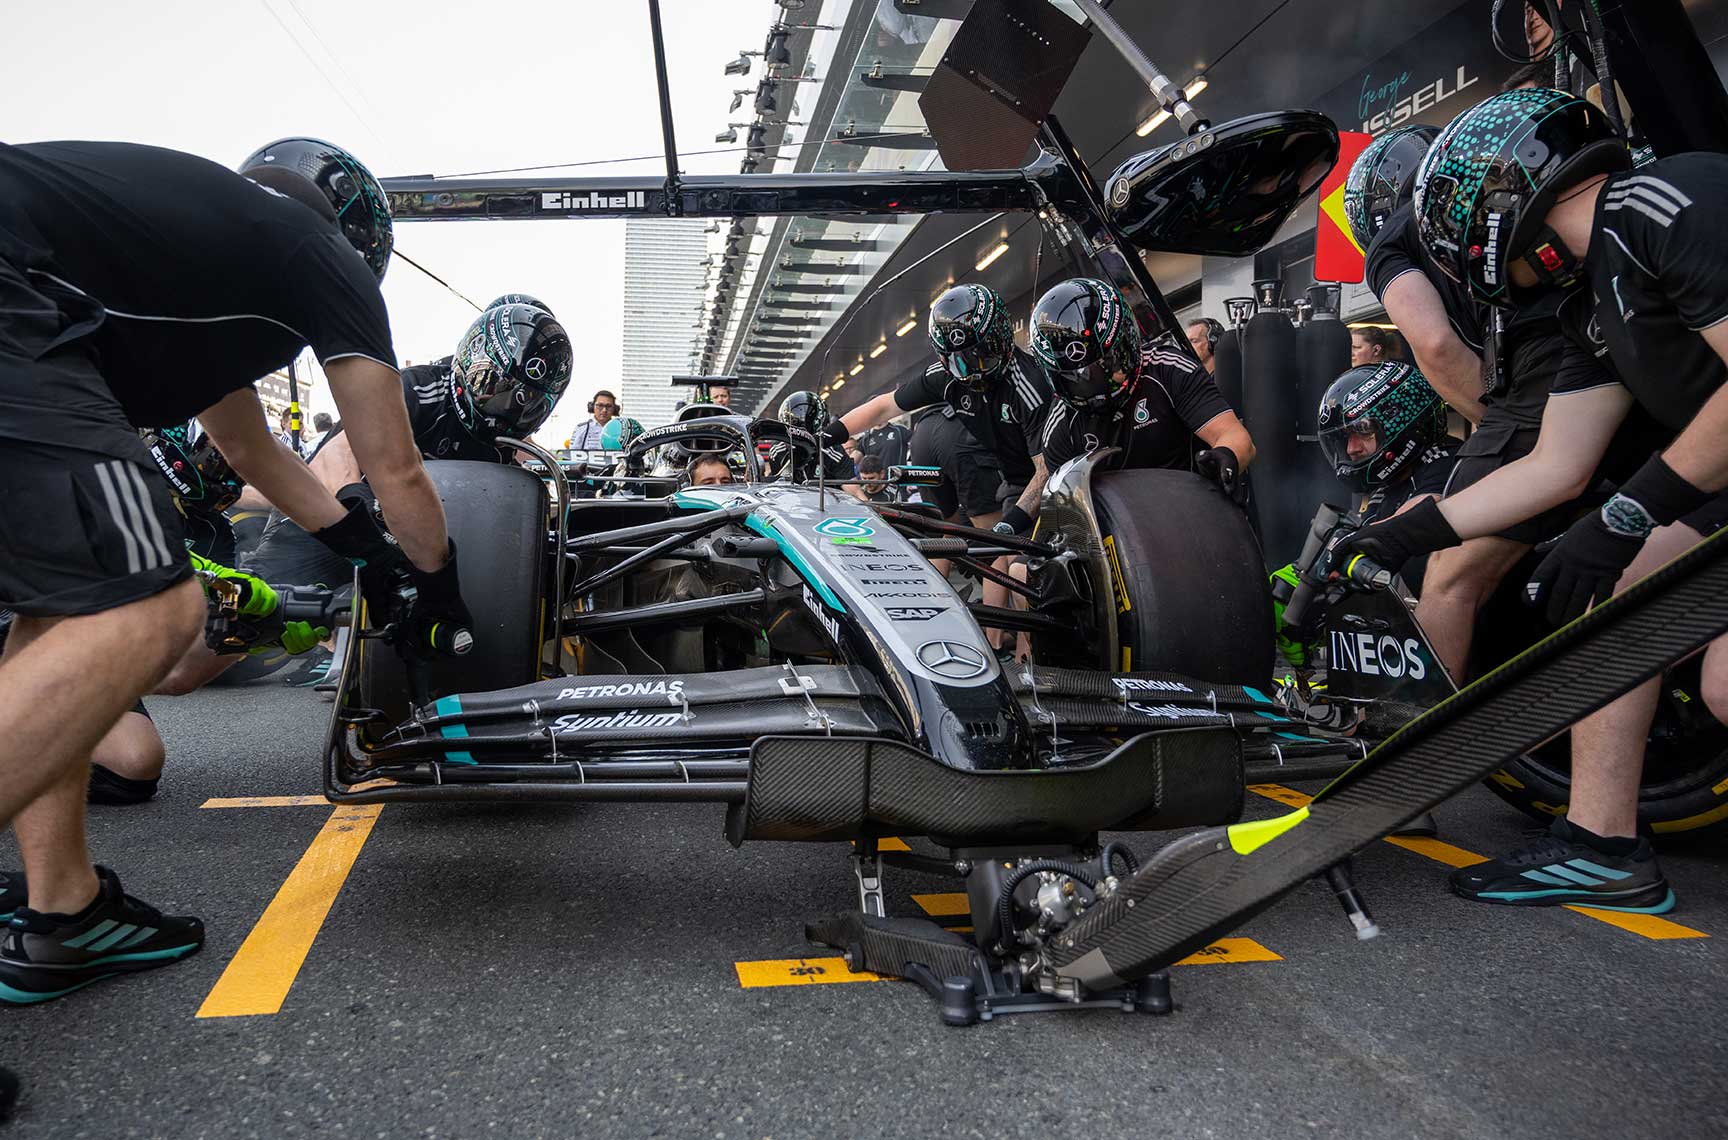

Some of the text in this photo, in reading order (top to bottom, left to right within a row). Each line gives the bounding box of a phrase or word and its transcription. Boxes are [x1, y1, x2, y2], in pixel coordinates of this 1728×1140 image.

[1350, 65, 1479, 138] SSELL
[542, 191, 644, 209] Einhell
[1484, 213, 1502, 285] Einhell
[1098, 285, 1111, 320] SOLERA
[1359, 365, 1395, 395] SOLERA
[1348, 384, 1391, 416] CROWDSTRIKE
[639, 423, 688, 442] CROWDSTRIKE
[151, 445, 191, 494] Einhell
[531, 464, 571, 472] PETAS
[1376, 440, 1417, 480] Einhell
[841, 563, 925, 572] INEOS
[802, 583, 840, 643] Einhell
[887, 608, 940, 620] SAP
[1330, 630, 1426, 680] INEOS
[556, 680, 684, 701] PETRONAS
[1111, 678, 1194, 693] PETRONAS
[550, 709, 682, 734] Syntium
